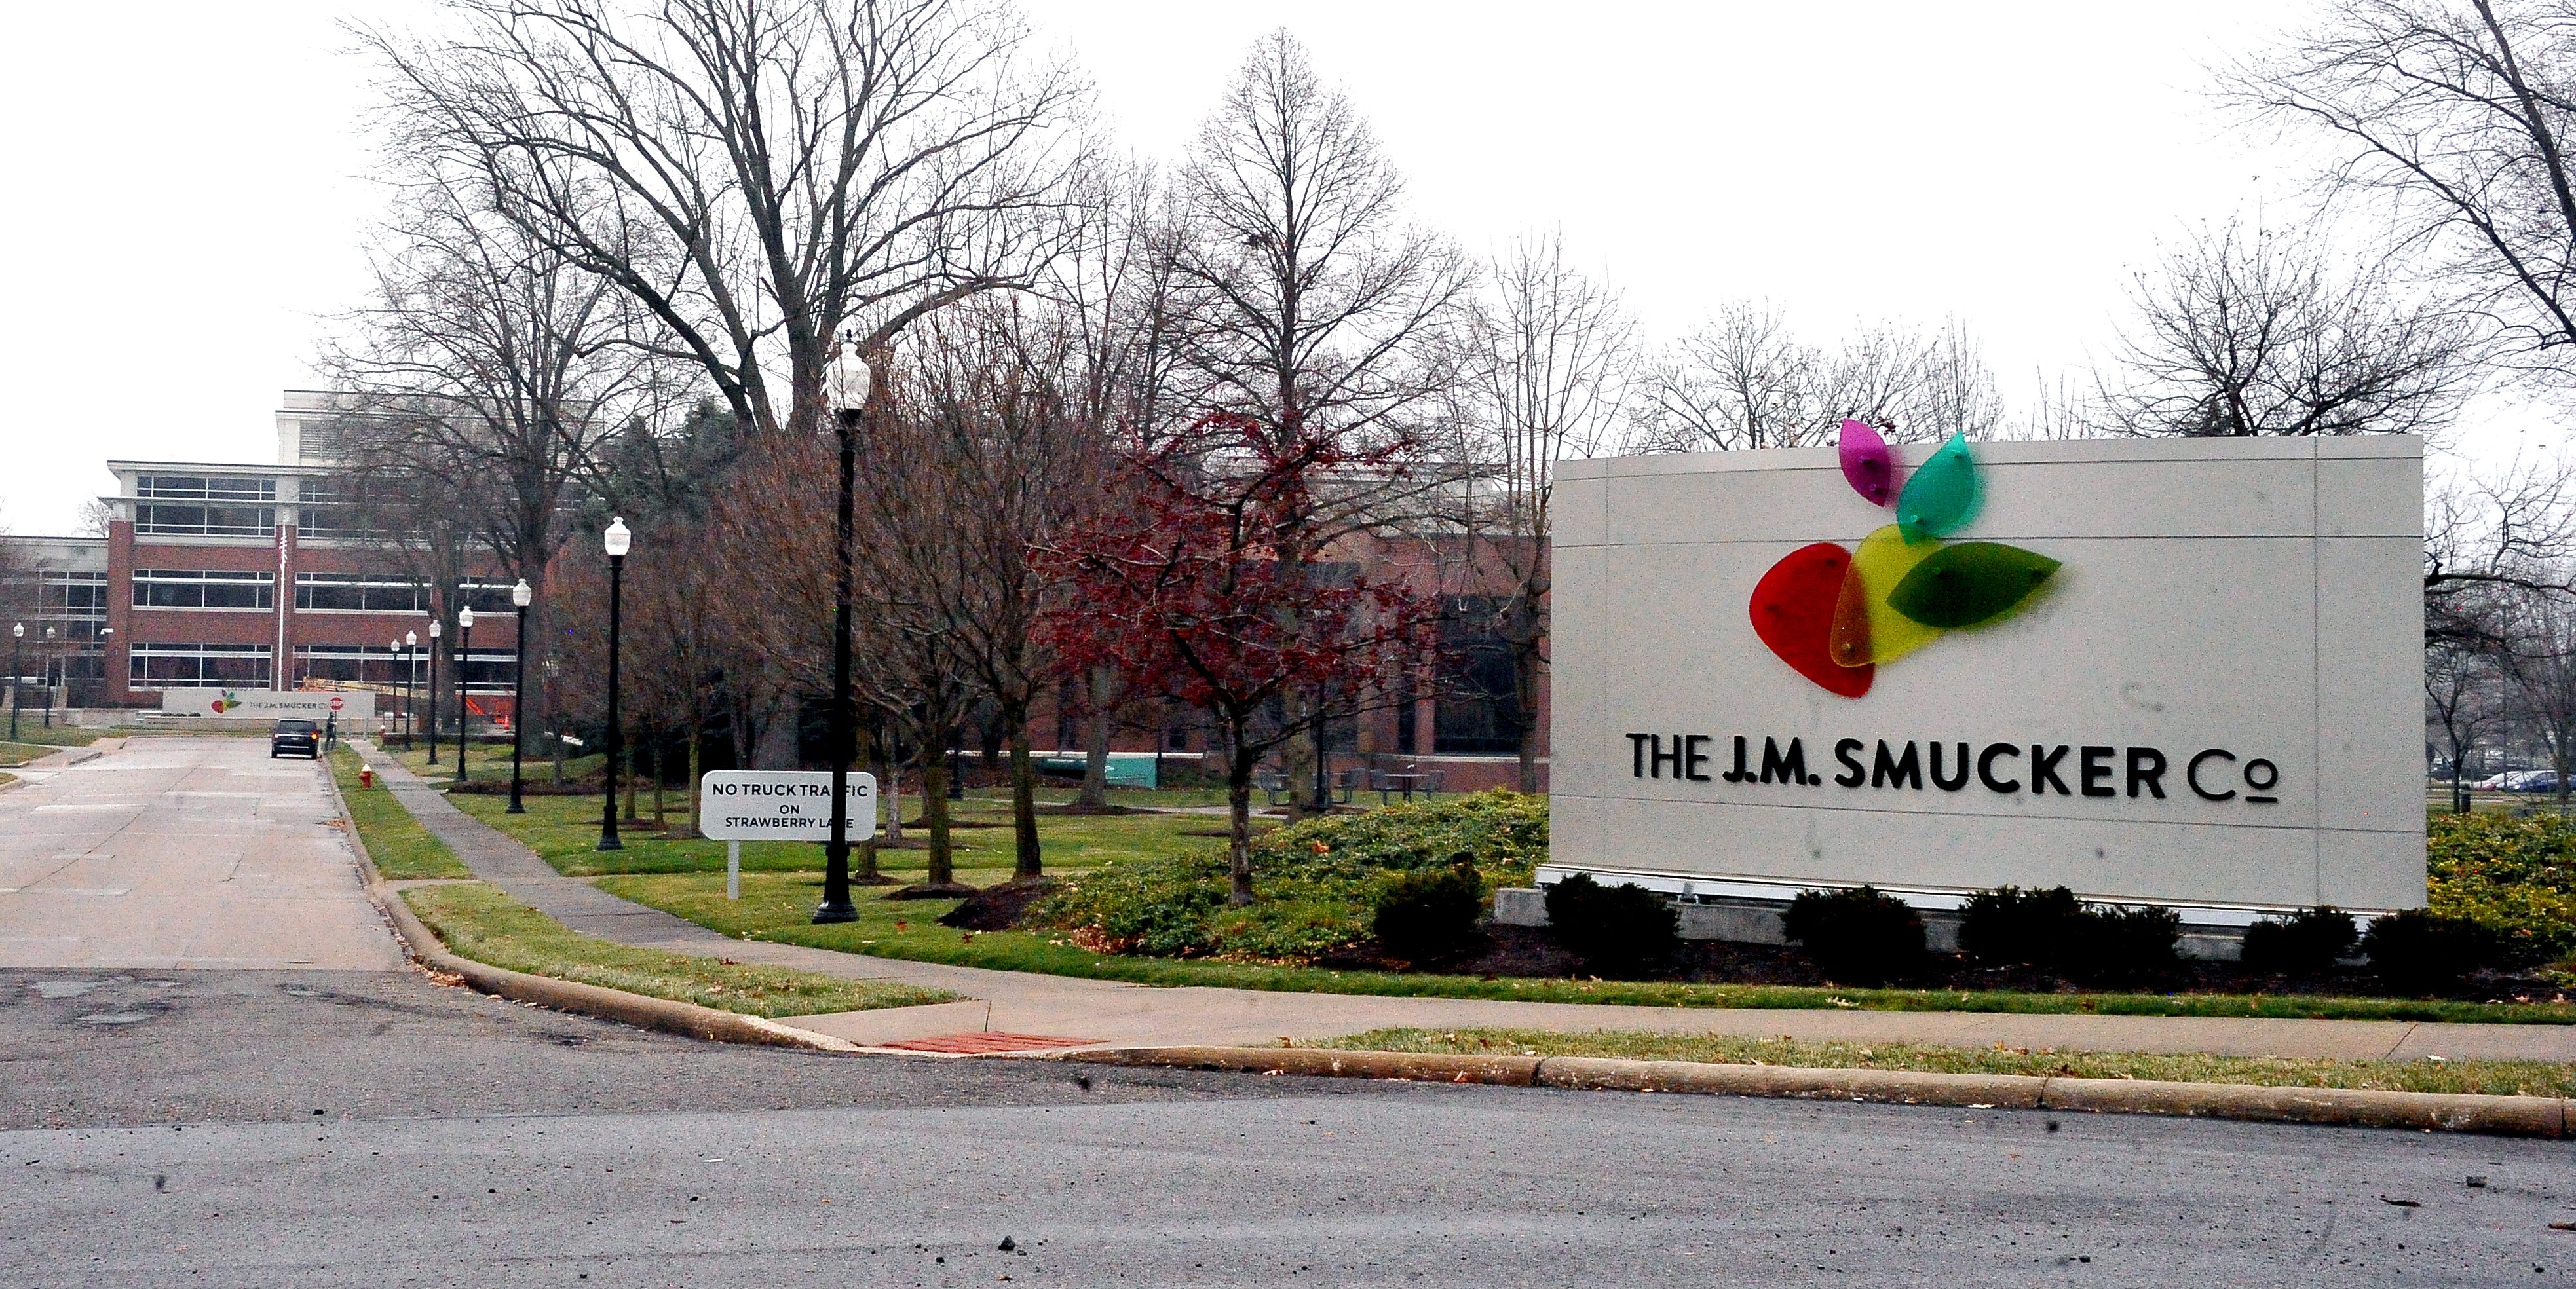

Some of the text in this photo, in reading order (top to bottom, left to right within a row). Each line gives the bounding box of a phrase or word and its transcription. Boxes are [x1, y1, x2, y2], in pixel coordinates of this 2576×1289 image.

[1625, 733, 1711, 781] THE
[1722, 736, 1822, 785] J.M.
[1834, 738, 2167, 799] SMUCKER
[713, 783, 738, 796] NO
[741, 784, 797, 796] TRUCK
[779, 804, 800, 815] ON
[725, 817, 854, 829] STRAWBERRY LAE
